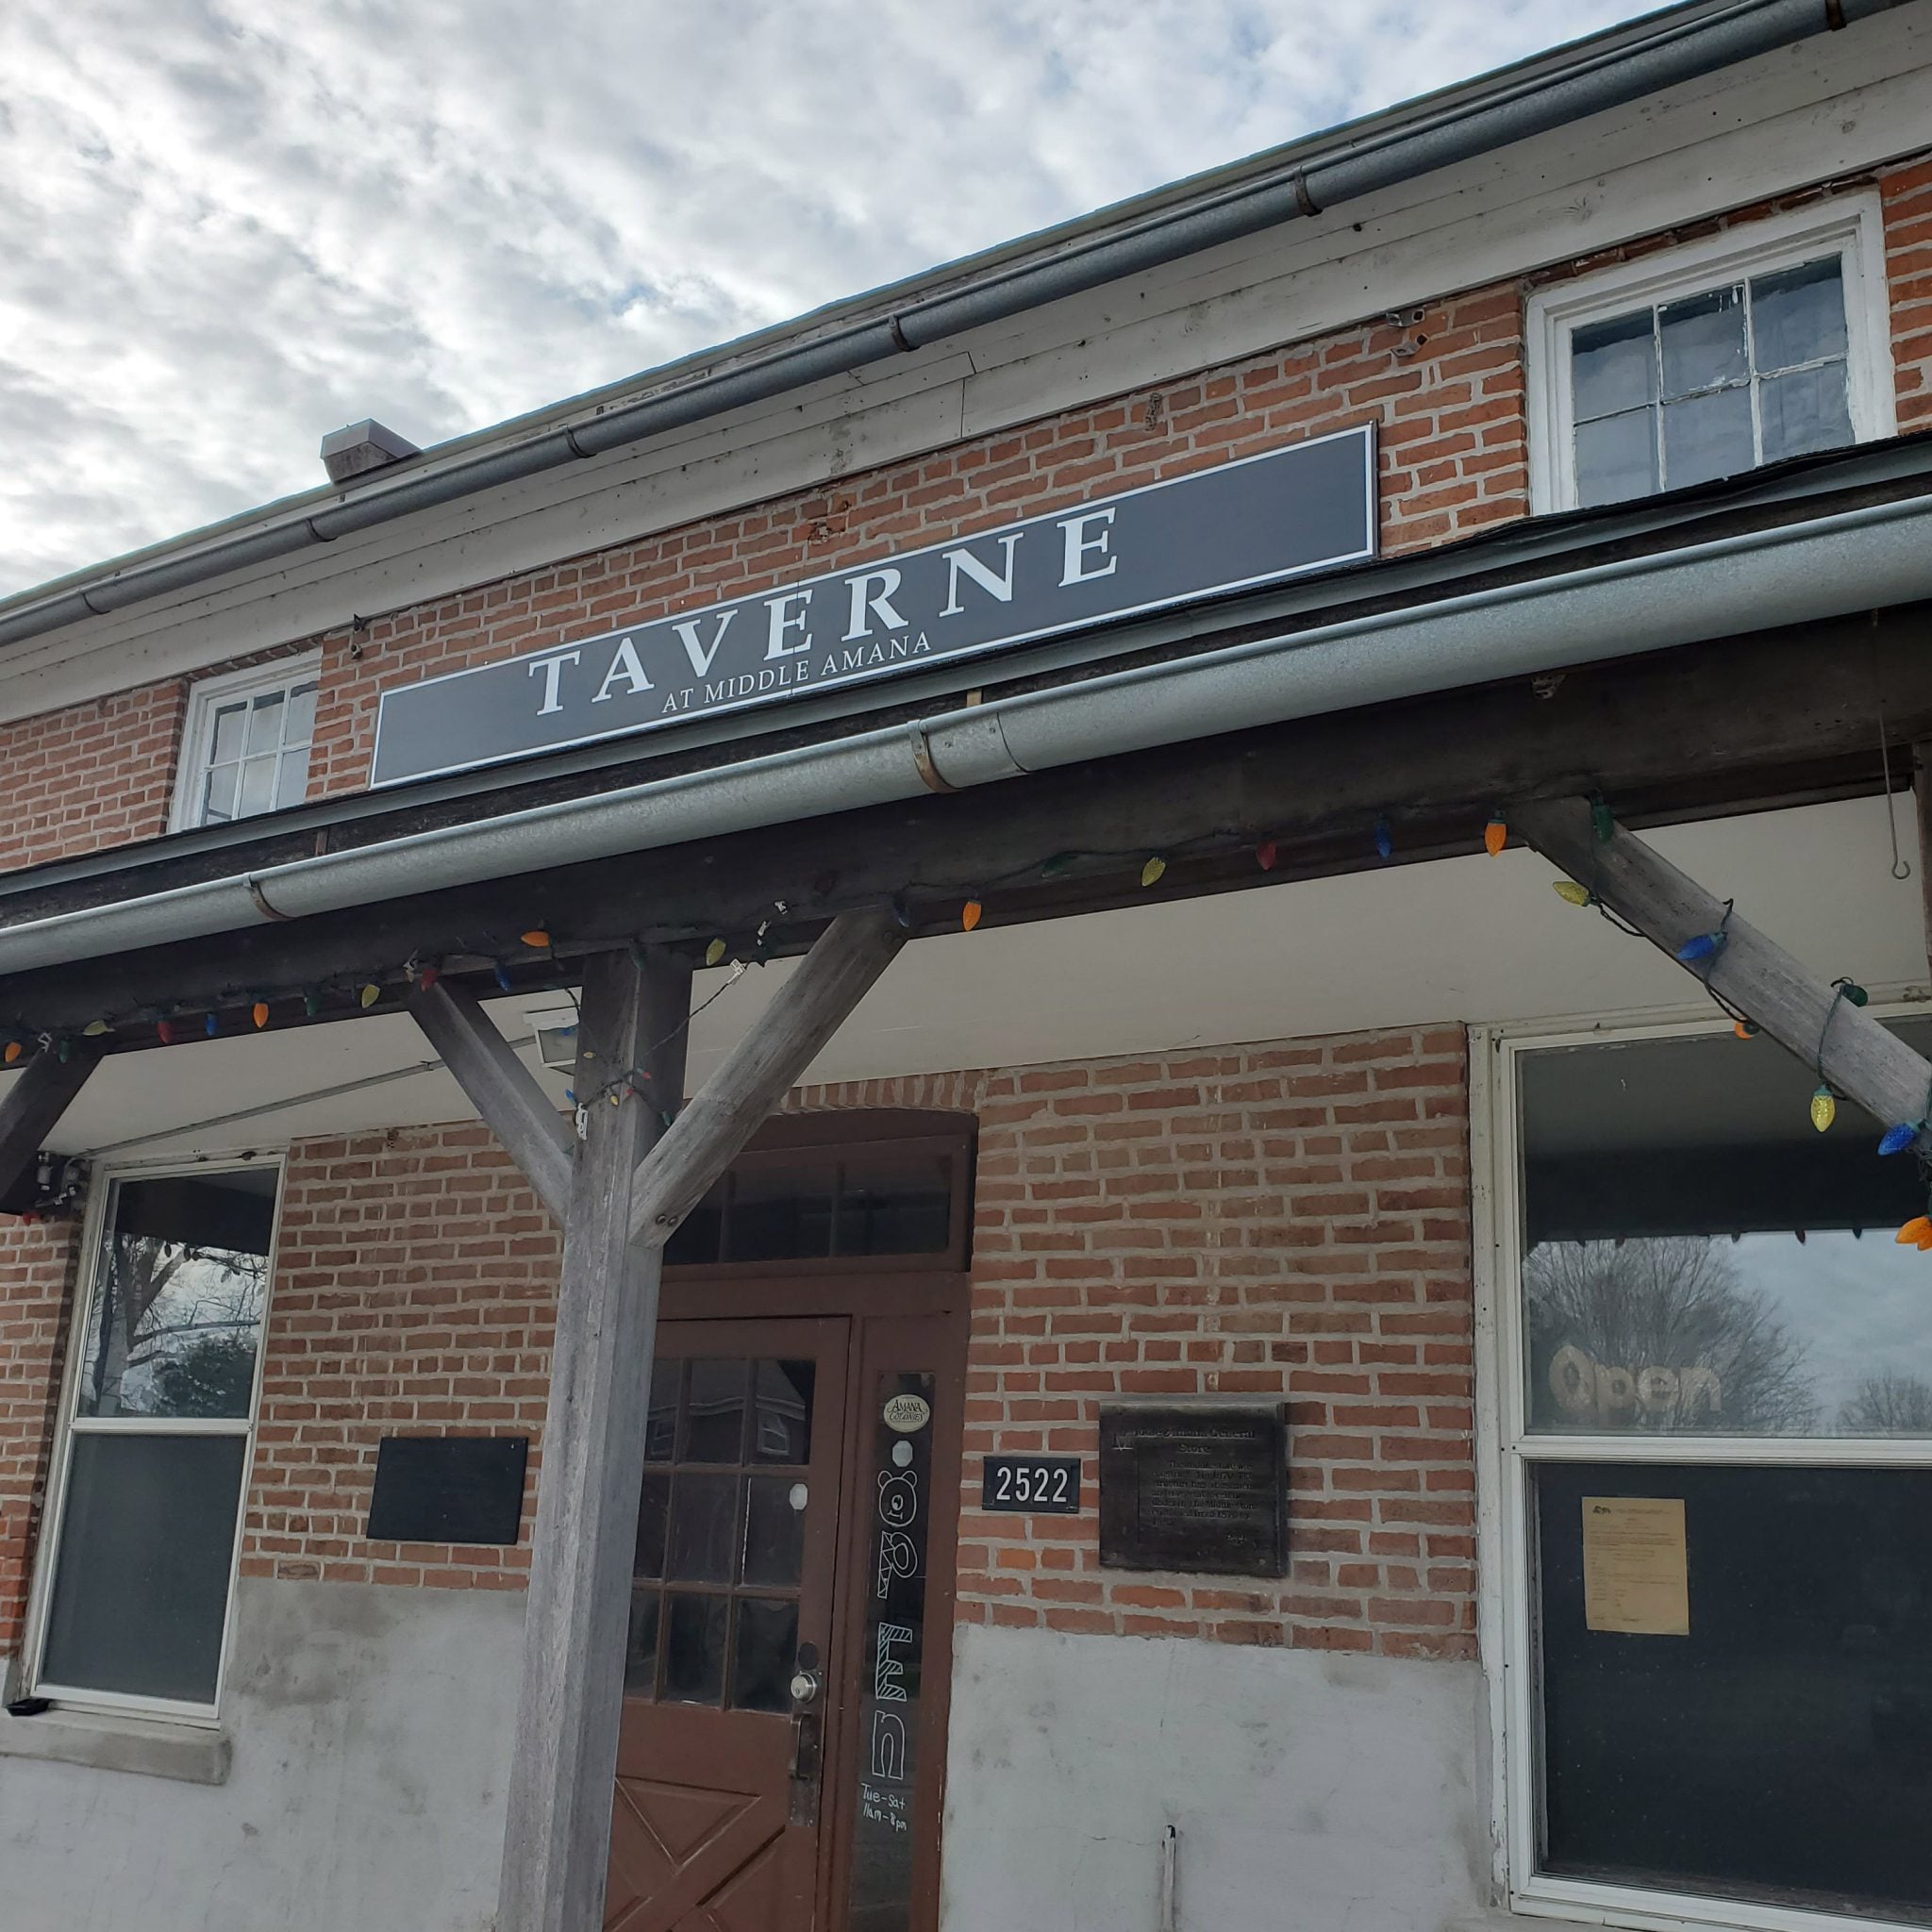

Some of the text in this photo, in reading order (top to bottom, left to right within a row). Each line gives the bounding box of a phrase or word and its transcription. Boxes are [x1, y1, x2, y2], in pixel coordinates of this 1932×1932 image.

[528, 506, 1120, 717] TAVERNE
[661, 631, 932, 714] AT MIDDLE AMANA
[1548, 1345, 1722, 1427] Open
[995, 1465, 1069, 1504] 2522
